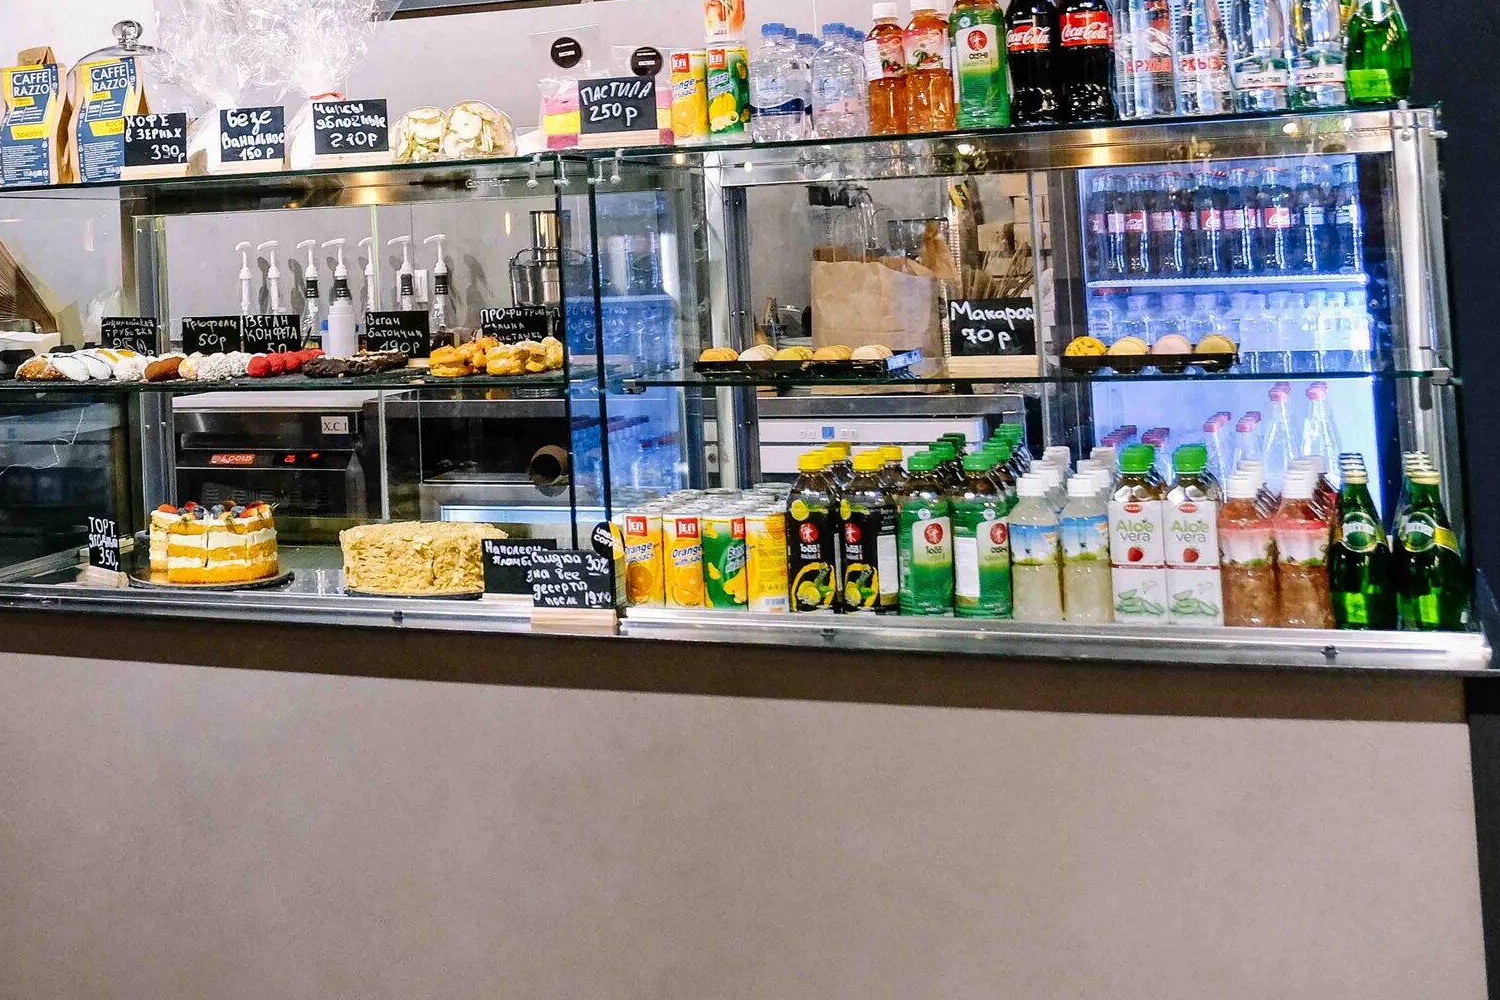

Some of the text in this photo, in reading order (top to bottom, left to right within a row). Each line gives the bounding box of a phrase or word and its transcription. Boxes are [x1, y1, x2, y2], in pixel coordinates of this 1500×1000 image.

[1006, 26, 1051, 47] Coca-Cola
[1062, 20, 1109, 42] Coca-Cola
[1182, 57, 1220, 72] РХЫЗ
[12, 71, 49, 86] CAFFE
[92, 66, 126, 81] CAFFE
[13, 84, 50, 97] RAZZO
[93, 78, 128, 92] RAZZO
[580, 81, 653, 106] ПАСТИЛА
[314, 103, 364, 115] Чипсы
[589, 102, 622, 122] 250
[136, 128, 181, 140] ЗЕРНАХ
[238, 148, 262, 161] 150
[245, 315, 288, 328] ВЕГАН
[366, 315, 401, 327] Веган
[244, 327, 298, 342] КОНФЕТА
[961, 328, 994, 344] 70
[1116, 520, 1154, 533] Aloe
[1171, 520, 1209, 533] Aloe
[1121, 532, 1151, 542] vera
[1176, 533, 1206, 543] vera
[625, 543, 652, 556] Orange
[585, 554, 609, 574] 30%
